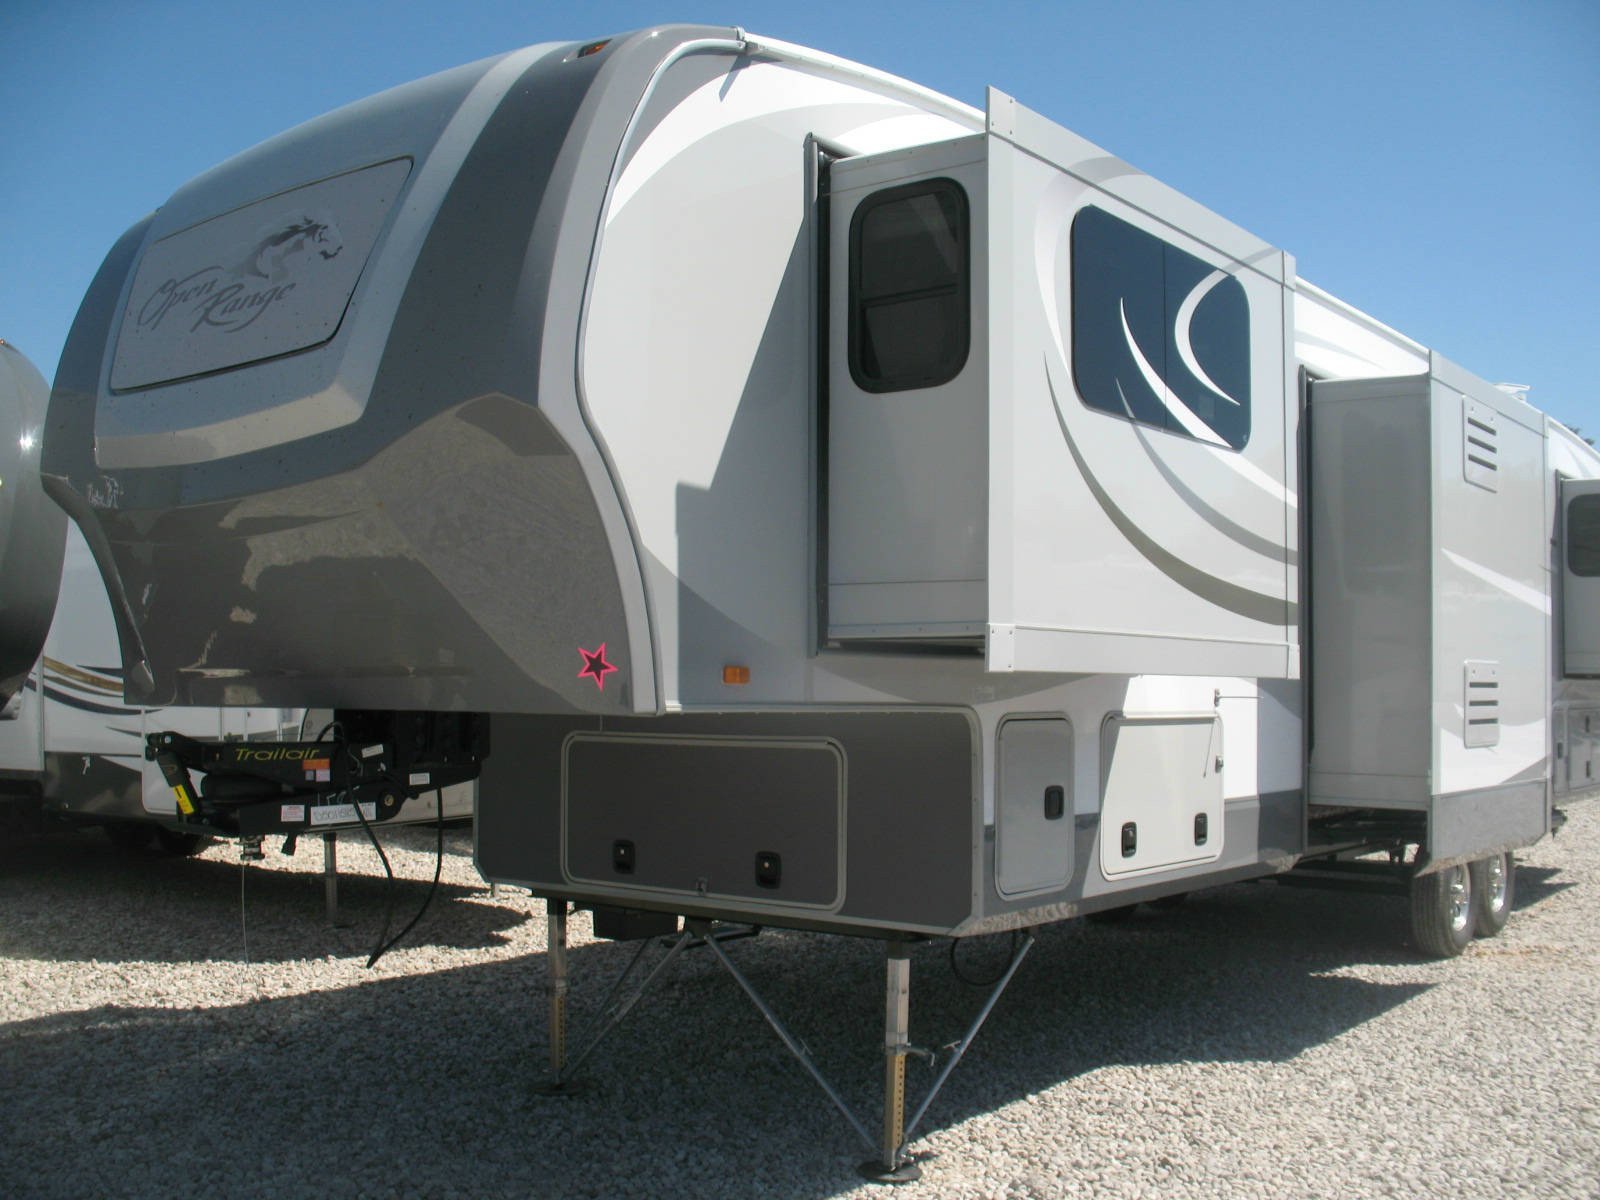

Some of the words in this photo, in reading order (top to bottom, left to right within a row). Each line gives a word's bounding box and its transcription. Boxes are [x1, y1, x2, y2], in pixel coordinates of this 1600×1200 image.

[137, 265, 224, 331] Open
[190, 283, 297, 333] Range
[235, 747, 319, 761] Trailair
